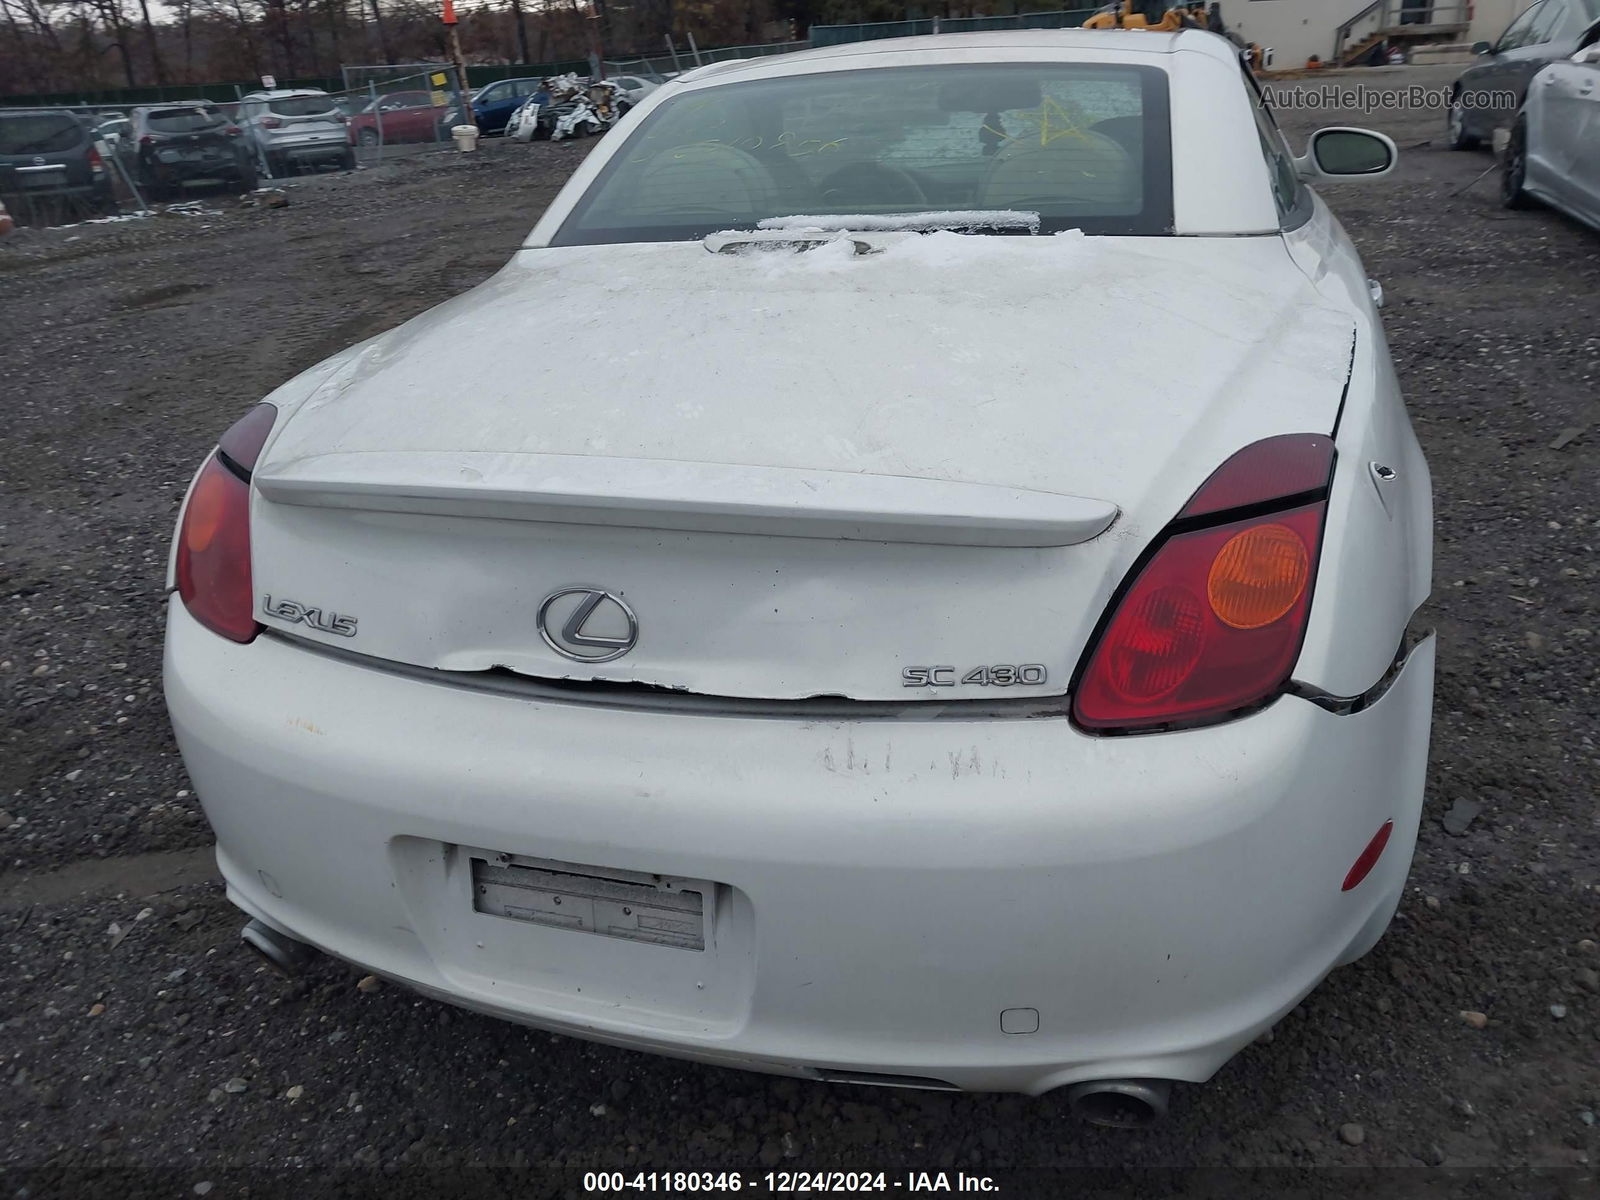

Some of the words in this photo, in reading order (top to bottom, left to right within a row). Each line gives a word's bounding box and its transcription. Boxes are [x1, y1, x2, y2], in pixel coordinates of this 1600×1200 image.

[263, 594, 358, 637] LEXUS
[902, 665, 955, 687] SC
[961, 664, 1048, 687] 430
